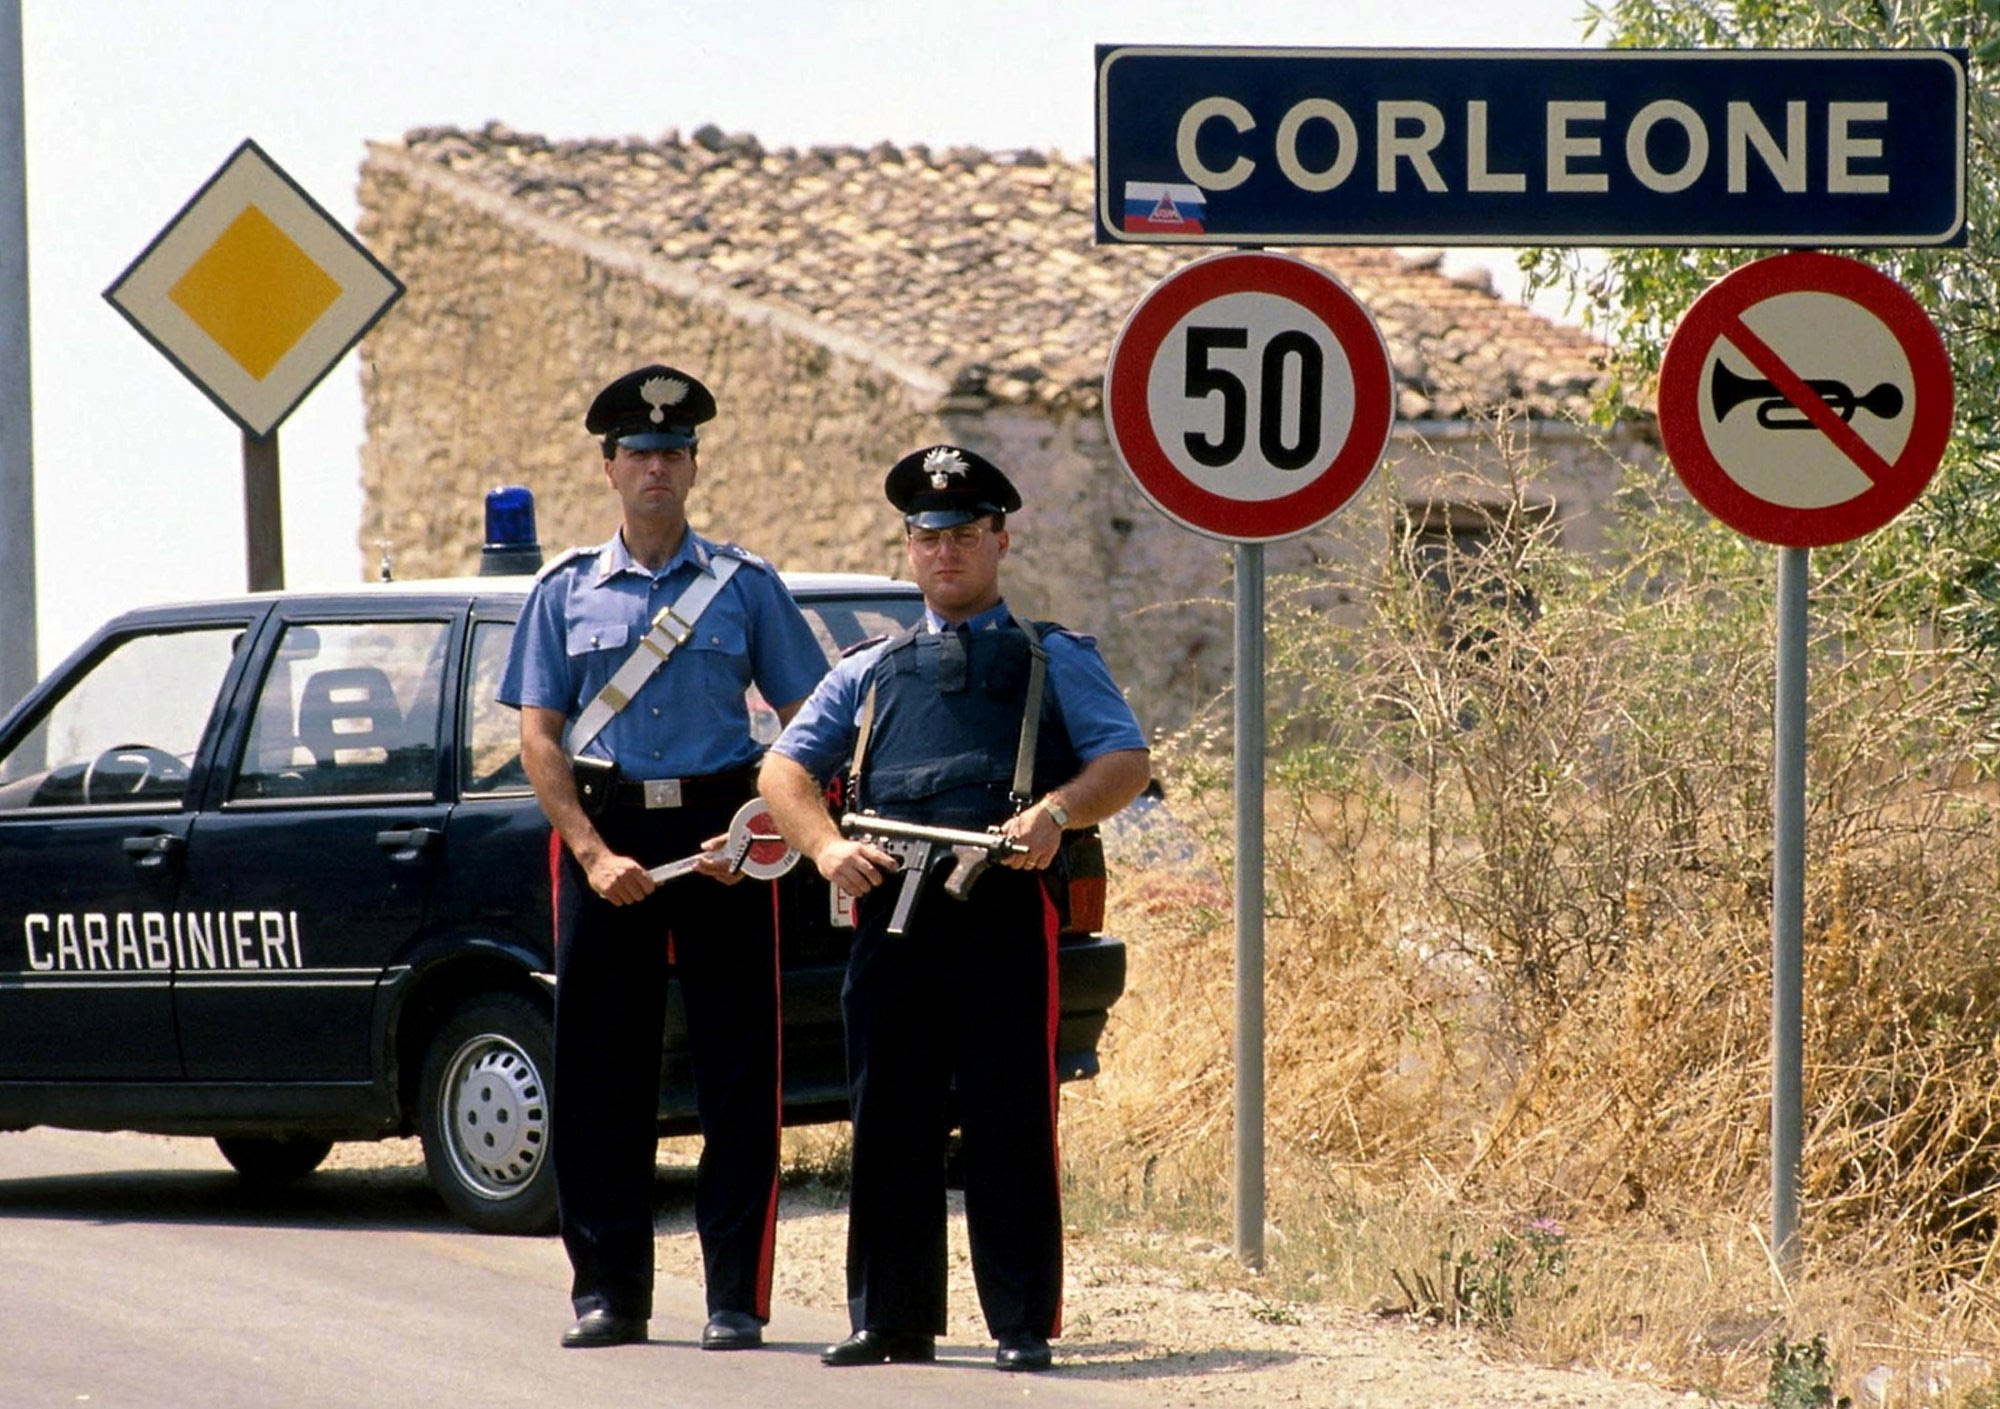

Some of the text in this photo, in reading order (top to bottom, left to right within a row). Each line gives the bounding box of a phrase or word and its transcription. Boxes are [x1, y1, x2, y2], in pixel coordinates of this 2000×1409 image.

[1176, 96, 1890, 194] CORLEONE
[1183, 326, 1323, 470] 50
[25, 911, 302, 970] CARABINIERI
